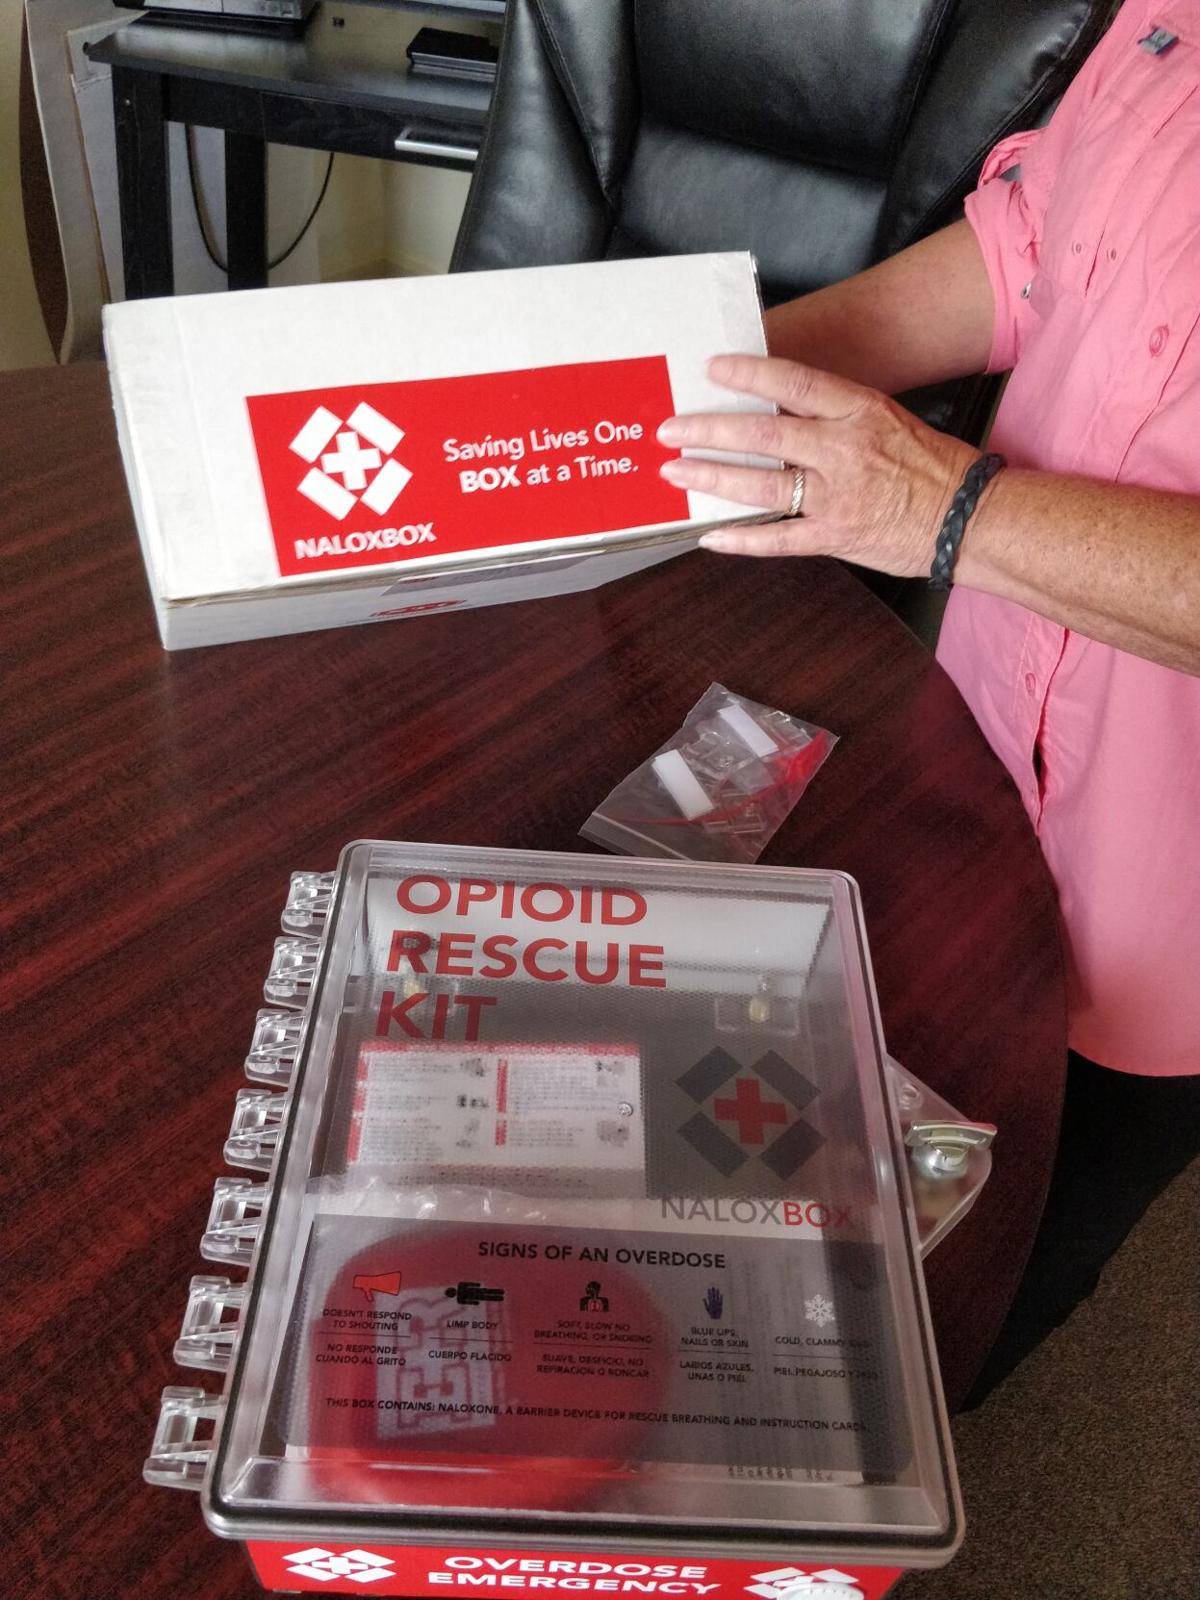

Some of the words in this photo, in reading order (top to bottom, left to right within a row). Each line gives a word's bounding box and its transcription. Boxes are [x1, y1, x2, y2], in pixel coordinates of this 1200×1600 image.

[442, 434, 525, 462] Saving
[529, 428, 589, 452] Lives
[594, 420, 644, 444] One
[459, 465, 521, 494] BOX
[527, 464, 551, 485] at
[556, 465, 571, 481] a
[573, 456, 639, 479] Time.
[295, 520, 437, 560] NALOXBOX
[396, 874, 648, 926] OPIOID
[386, 929, 667, 988] RESCUE
[375, 991, 498, 1043] KIT
[661, 1198, 851, 1229] NALOXBOX
[478, 1241, 538, 1260] SIGNS
[544, 1244, 573, 1261] OF
[579, 1247, 608, 1263] AN
[615, 1248, 726, 1269] OVERDOSE
[322, 1308, 364, 1318] DOESN'T
[367, 1310, 412, 1320] RESPOND
[332, 1320, 345, 1328] TO
[348, 1321, 398, 1331] SHOUTING
[446, 1319, 469, 1329] LIMP
[471, 1320, 499, 1330] BODY
[327, 1343, 342, 1352] NO
[345, 1344, 398, 1354] RESPONDE
[680, 1336, 708, 1346] NAILS
[711, 1338, 724, 1346] OR
[727, 1339, 749, 1348] SKIN
[315, 1354, 359, 1364] CUANDO
[360, 1356, 374, 1365] AL
[376, 1357, 406, 1366] GRITO
[428, 1350, 467, 1360] CUERPO
[470, 1351, 512, 1362] FLACIDO
[326, 1398, 349, 1408] THIS
[352, 1399, 375, 1409] BOX
[377, 1400, 435, 1412] CONTAINS:
[438, 1402, 503, 1416] NALOXONE,
[505, 1406, 514, 1415] A
[516, 1407, 560, 1417] BARRIER
[563, 1409, 601, 1420] DEVICE
[604, 1410, 626, 1420] FOR
[628, 1411, 669, 1423] RESCUE
[672, 1414, 731, 1427] BREATHING
[733, 1416, 757, 1427] AND
[760, 1417, 830, 1430] INSTRUCTION
[444, 1556, 708, 1579] OVERDOSE
[428, 1571, 722, 1595] EMERGENCY
